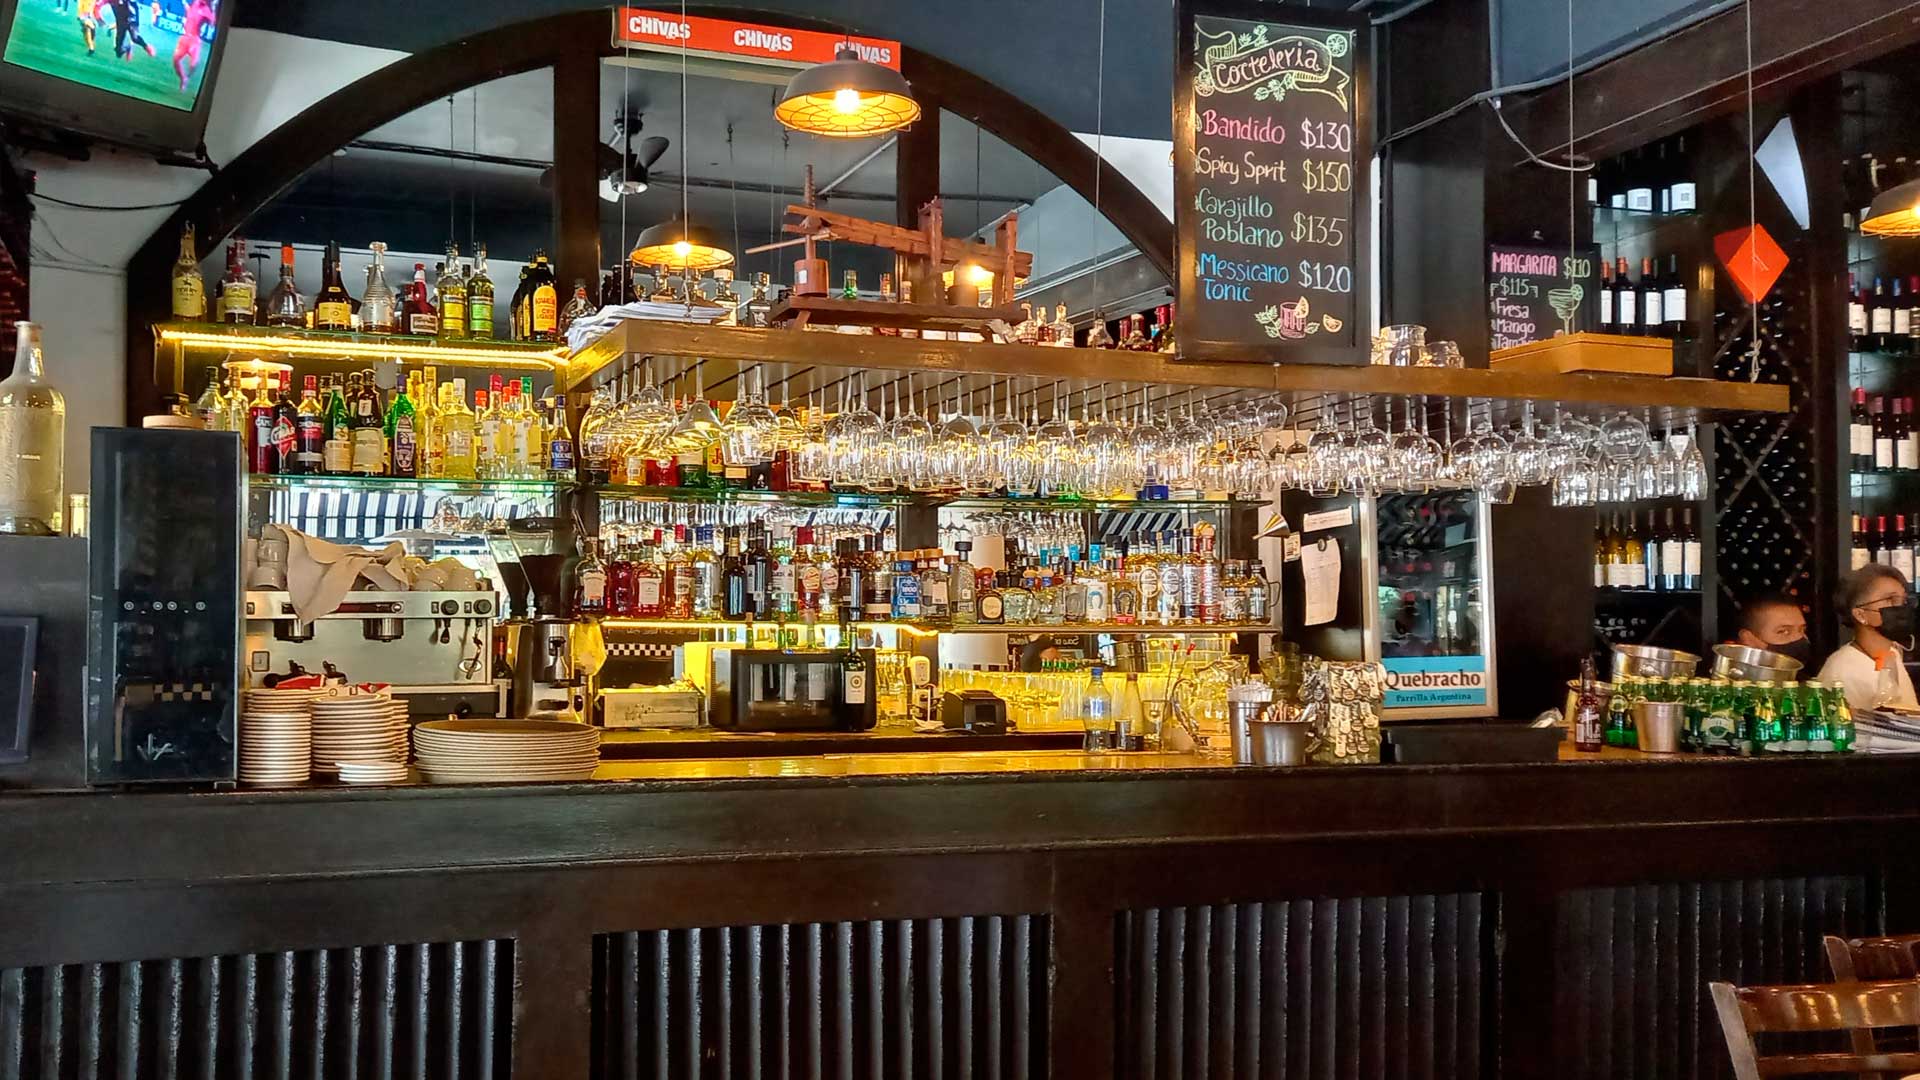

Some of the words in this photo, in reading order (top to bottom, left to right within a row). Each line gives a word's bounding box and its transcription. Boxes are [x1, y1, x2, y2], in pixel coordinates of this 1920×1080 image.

[629, 16, 691, 40] CHIVAS
[734, 29, 793, 52] CHIVAS
[1202, 109, 1286, 144] Bandido
[1300, 117, 1352, 153] $130
[1197, 147, 1240, 184] Spicy
[1244, 151, 1287, 184] Sprit
[1302, 158, 1352, 194] $150
[1197, 188, 1273, 223] Carajillo
[1201, 218, 1284, 248] Poblano
[1290, 211, 1347, 247] $135
[1200, 252, 1290, 284] Messicano
[1298, 260, 1352, 293] $120
[1491, 251, 1557, 276] MARGARITA
[1203, 278, 1254, 302] Tonic
[1499, 275, 1530, 296] $115
[1495, 297, 1530, 319] Fresa
[1496, 319, 1536, 339] Mango
[1385, 669, 1481, 691] Quebracho
[1396, 694, 1428, 703] Parrilla
[1430, 693, 1472, 703] Argentina
